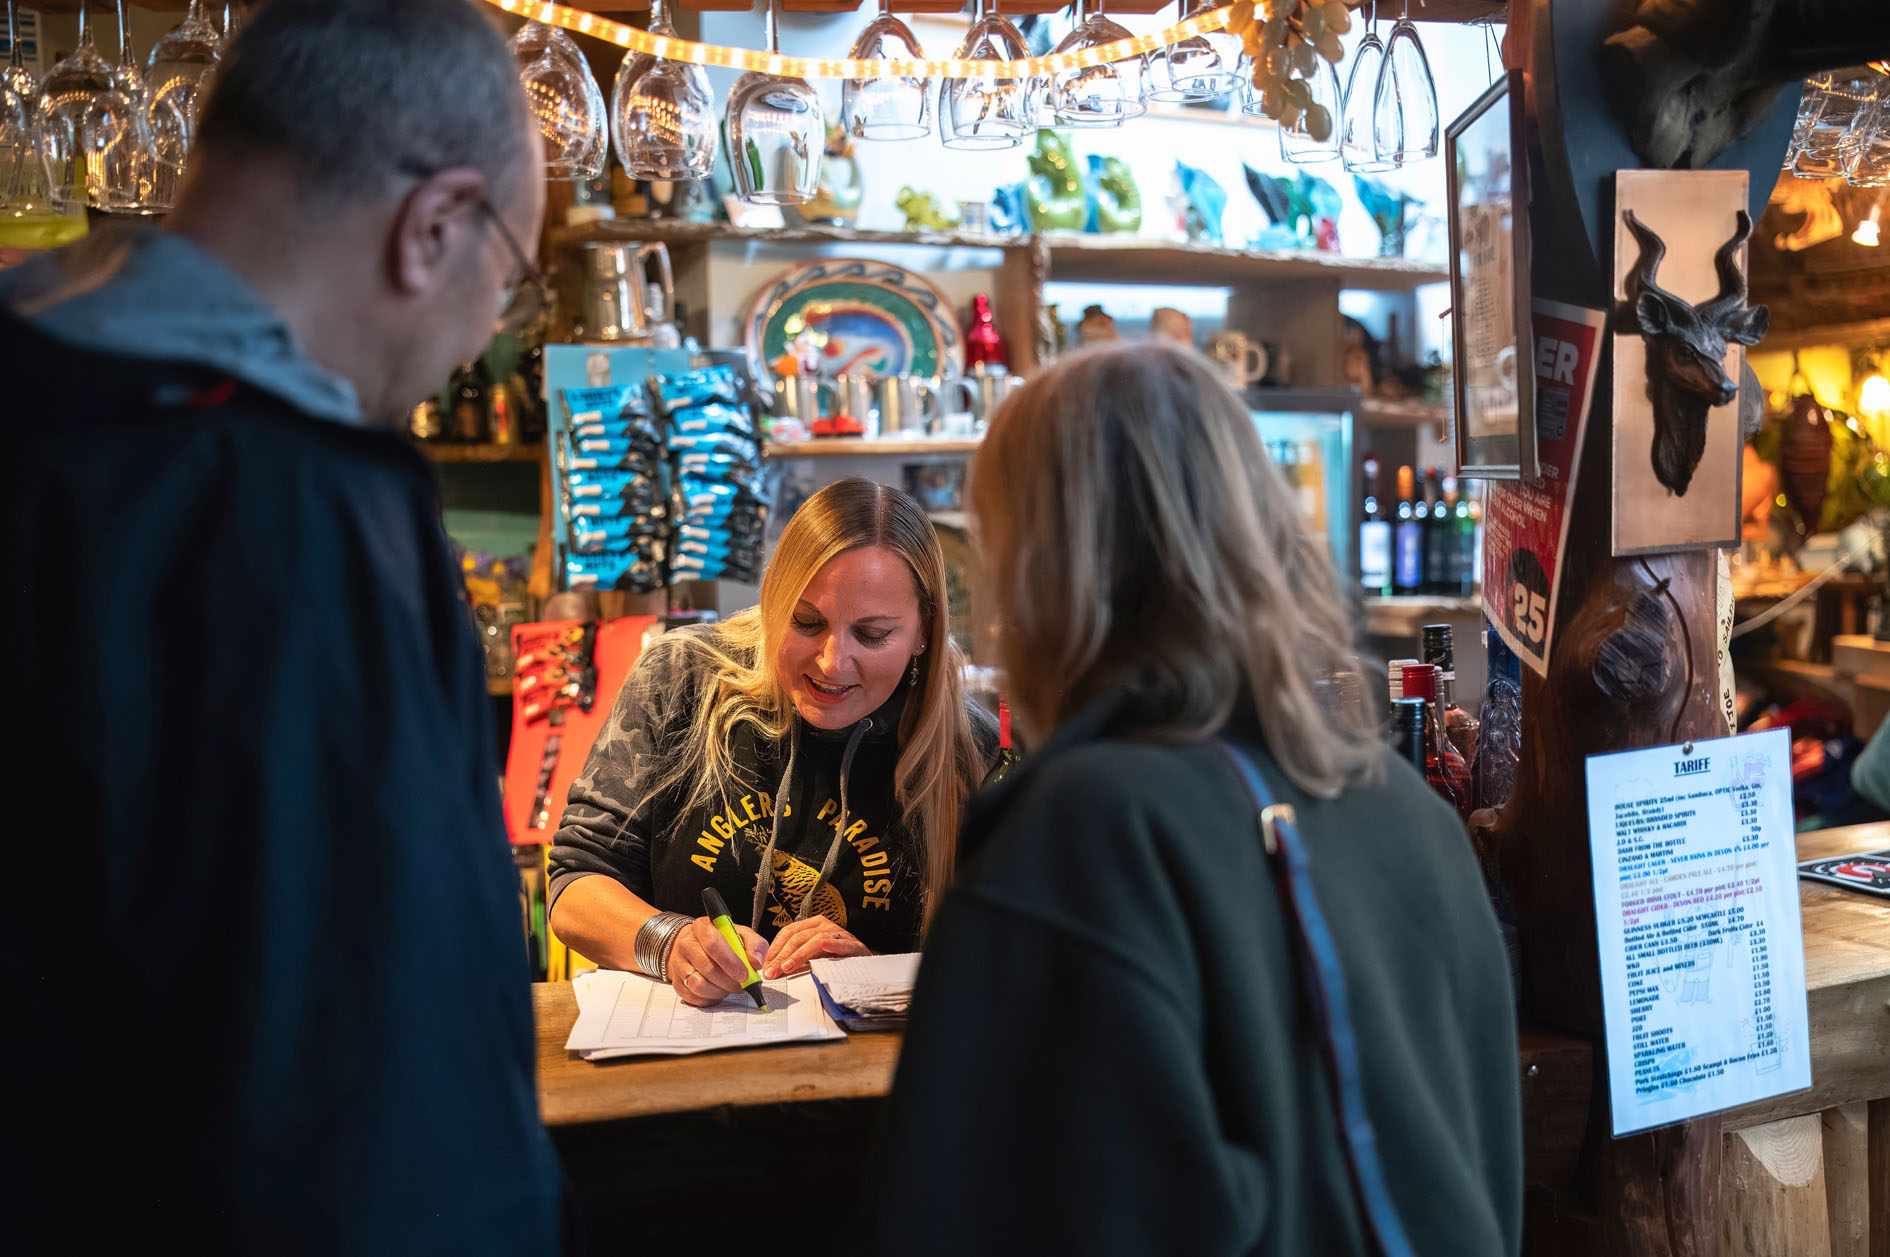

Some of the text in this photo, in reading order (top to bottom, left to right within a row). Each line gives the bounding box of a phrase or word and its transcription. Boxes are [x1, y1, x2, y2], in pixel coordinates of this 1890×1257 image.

[1514, 582, 1546, 643] 25
[1672, 756, 1711, 775] TARIFF
[816, 797, 892, 912] PARADISE
